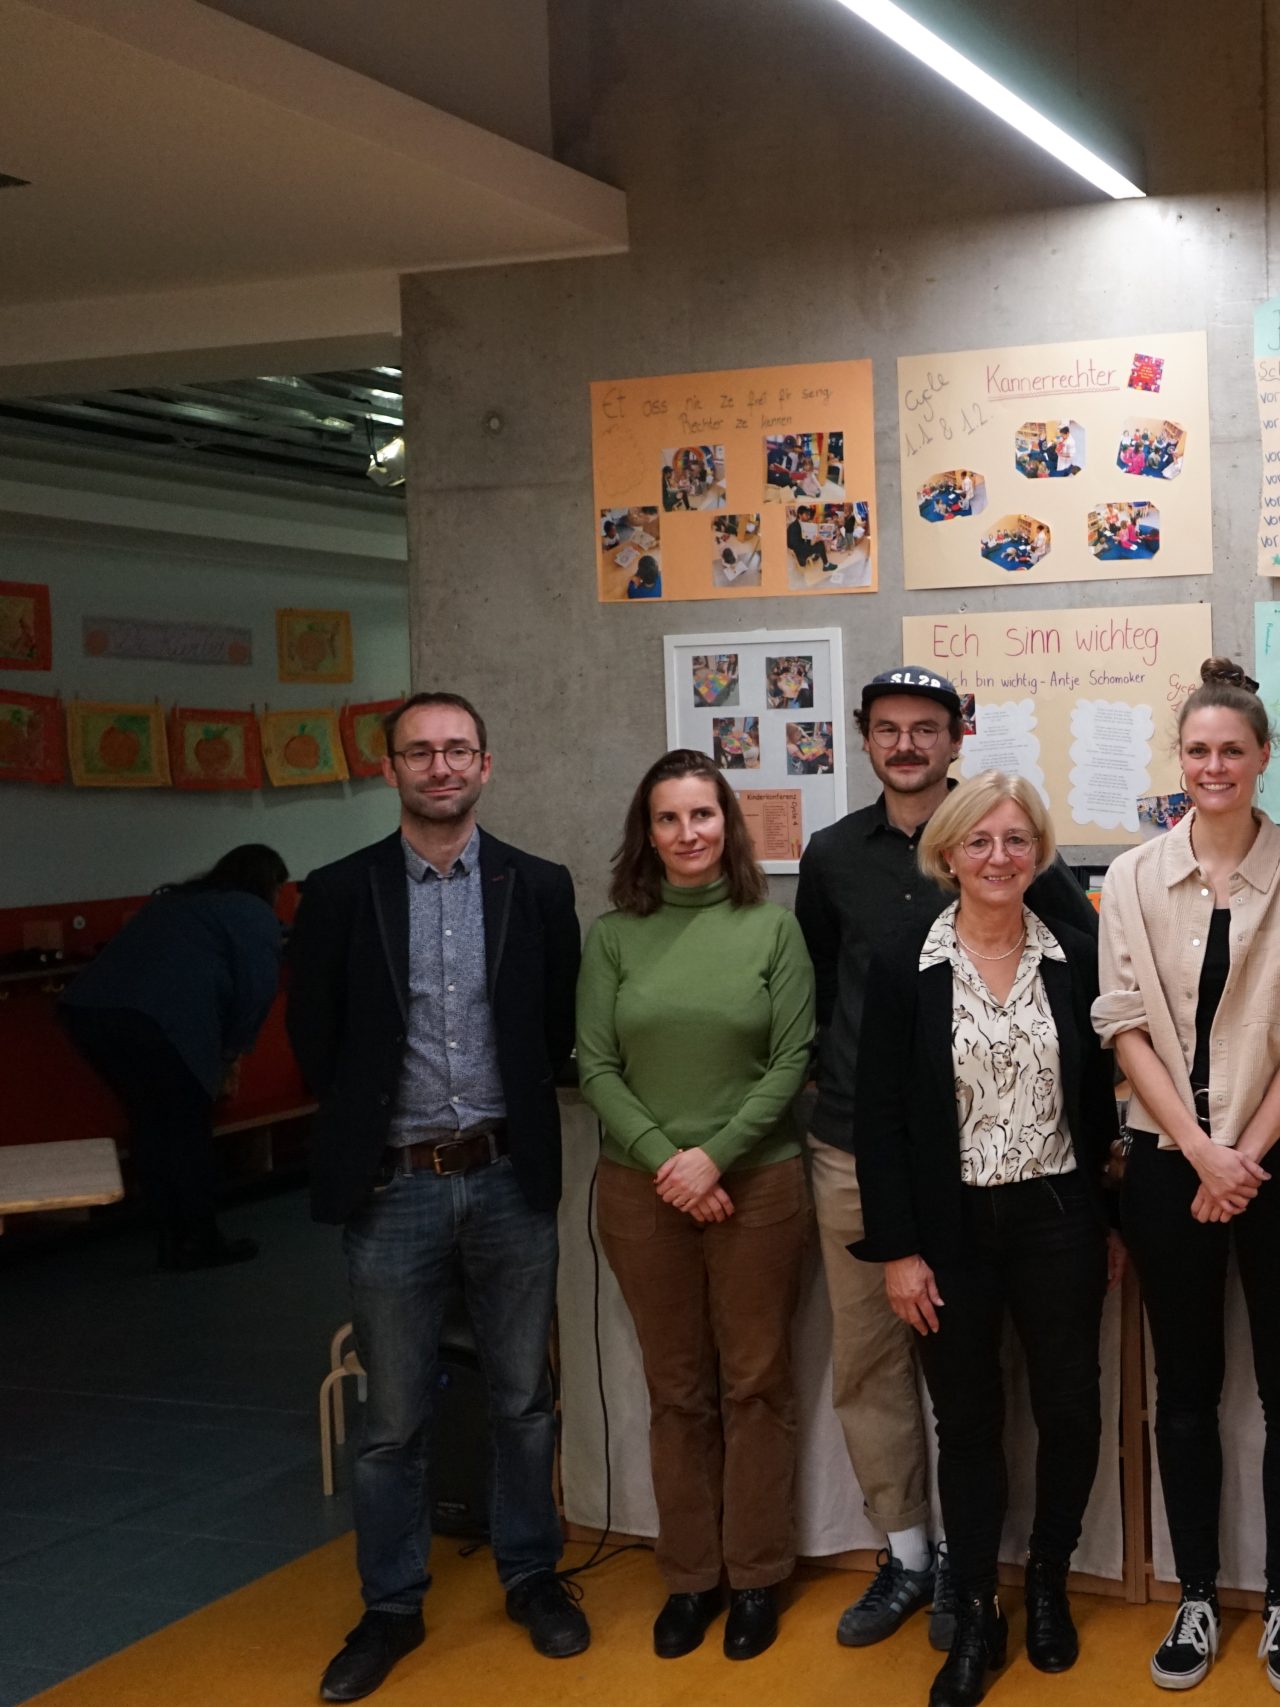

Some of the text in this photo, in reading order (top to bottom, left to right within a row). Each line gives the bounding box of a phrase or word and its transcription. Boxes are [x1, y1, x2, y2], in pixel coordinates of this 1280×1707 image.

[987, 359, 1117, 393] Kannerrechter
[602, 387, 626, 419] Et
[904, 372, 951, 422] Cycle
[1260, 390, 1280, 404] vor
[1263, 417, 1279, 429] vor
[1265, 450, 1280, 463] vor
[1260, 534, 1280, 548] vor
[933, 624, 979, 658] Ech
[1076, 618, 1159, 666] wichteg
[975, 670, 994, 688] bin
[1001, 672, 1038, 695] wichtig
[1050, 671, 1080, 690] Antje
